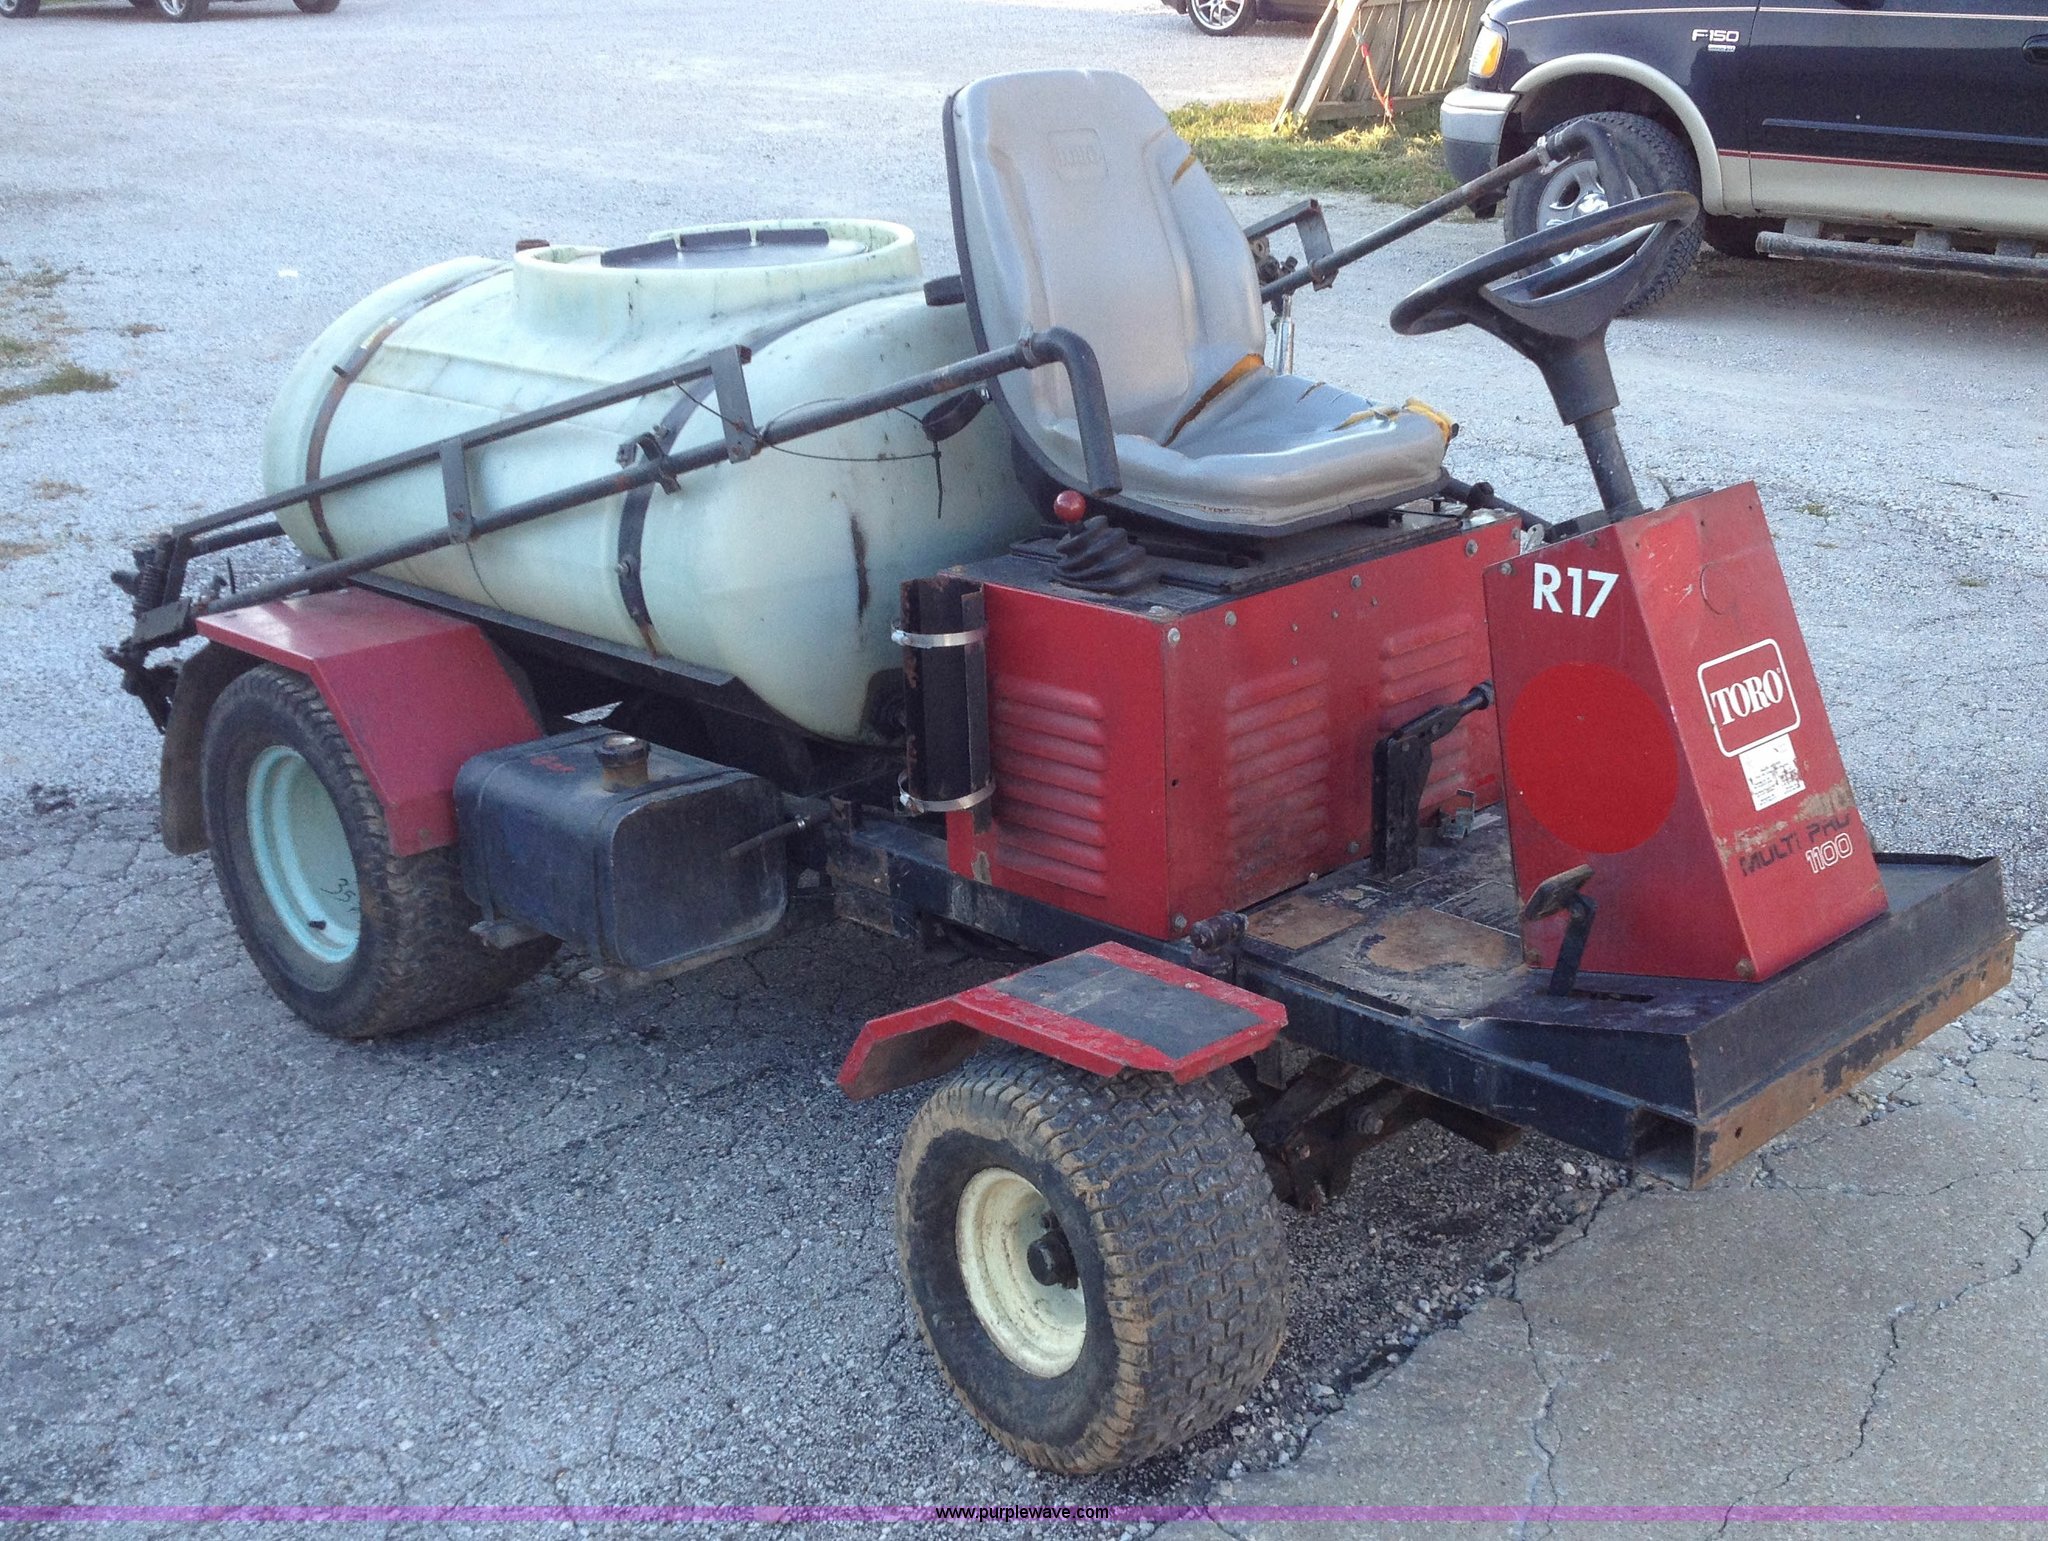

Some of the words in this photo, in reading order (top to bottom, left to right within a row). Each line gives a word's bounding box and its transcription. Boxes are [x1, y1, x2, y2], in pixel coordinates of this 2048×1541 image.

[1532, 562, 1620, 618] R17
[1709, 669, 1784, 726] TORO
[1805, 832, 1854, 874] 1100
